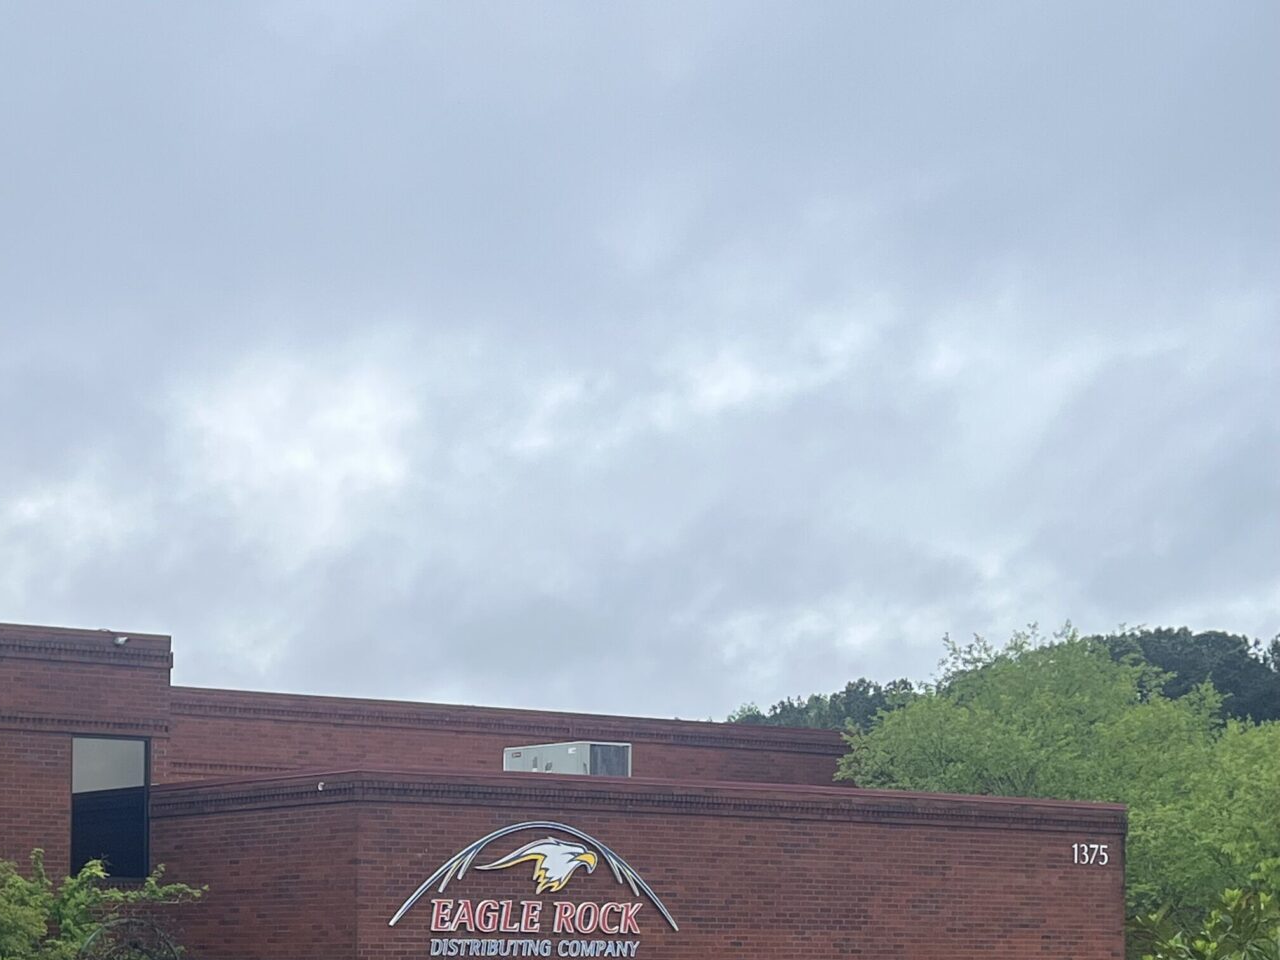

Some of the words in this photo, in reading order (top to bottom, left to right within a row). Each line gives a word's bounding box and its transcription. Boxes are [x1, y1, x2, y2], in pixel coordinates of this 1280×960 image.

[1071, 843, 1109, 865] 1375
[429, 899, 542, 933] EAGLE
[552, 901, 643, 934] ROCK
[429, 938, 552, 957] DISTRIBUTING
[557, 939, 640, 958] COMPANY
